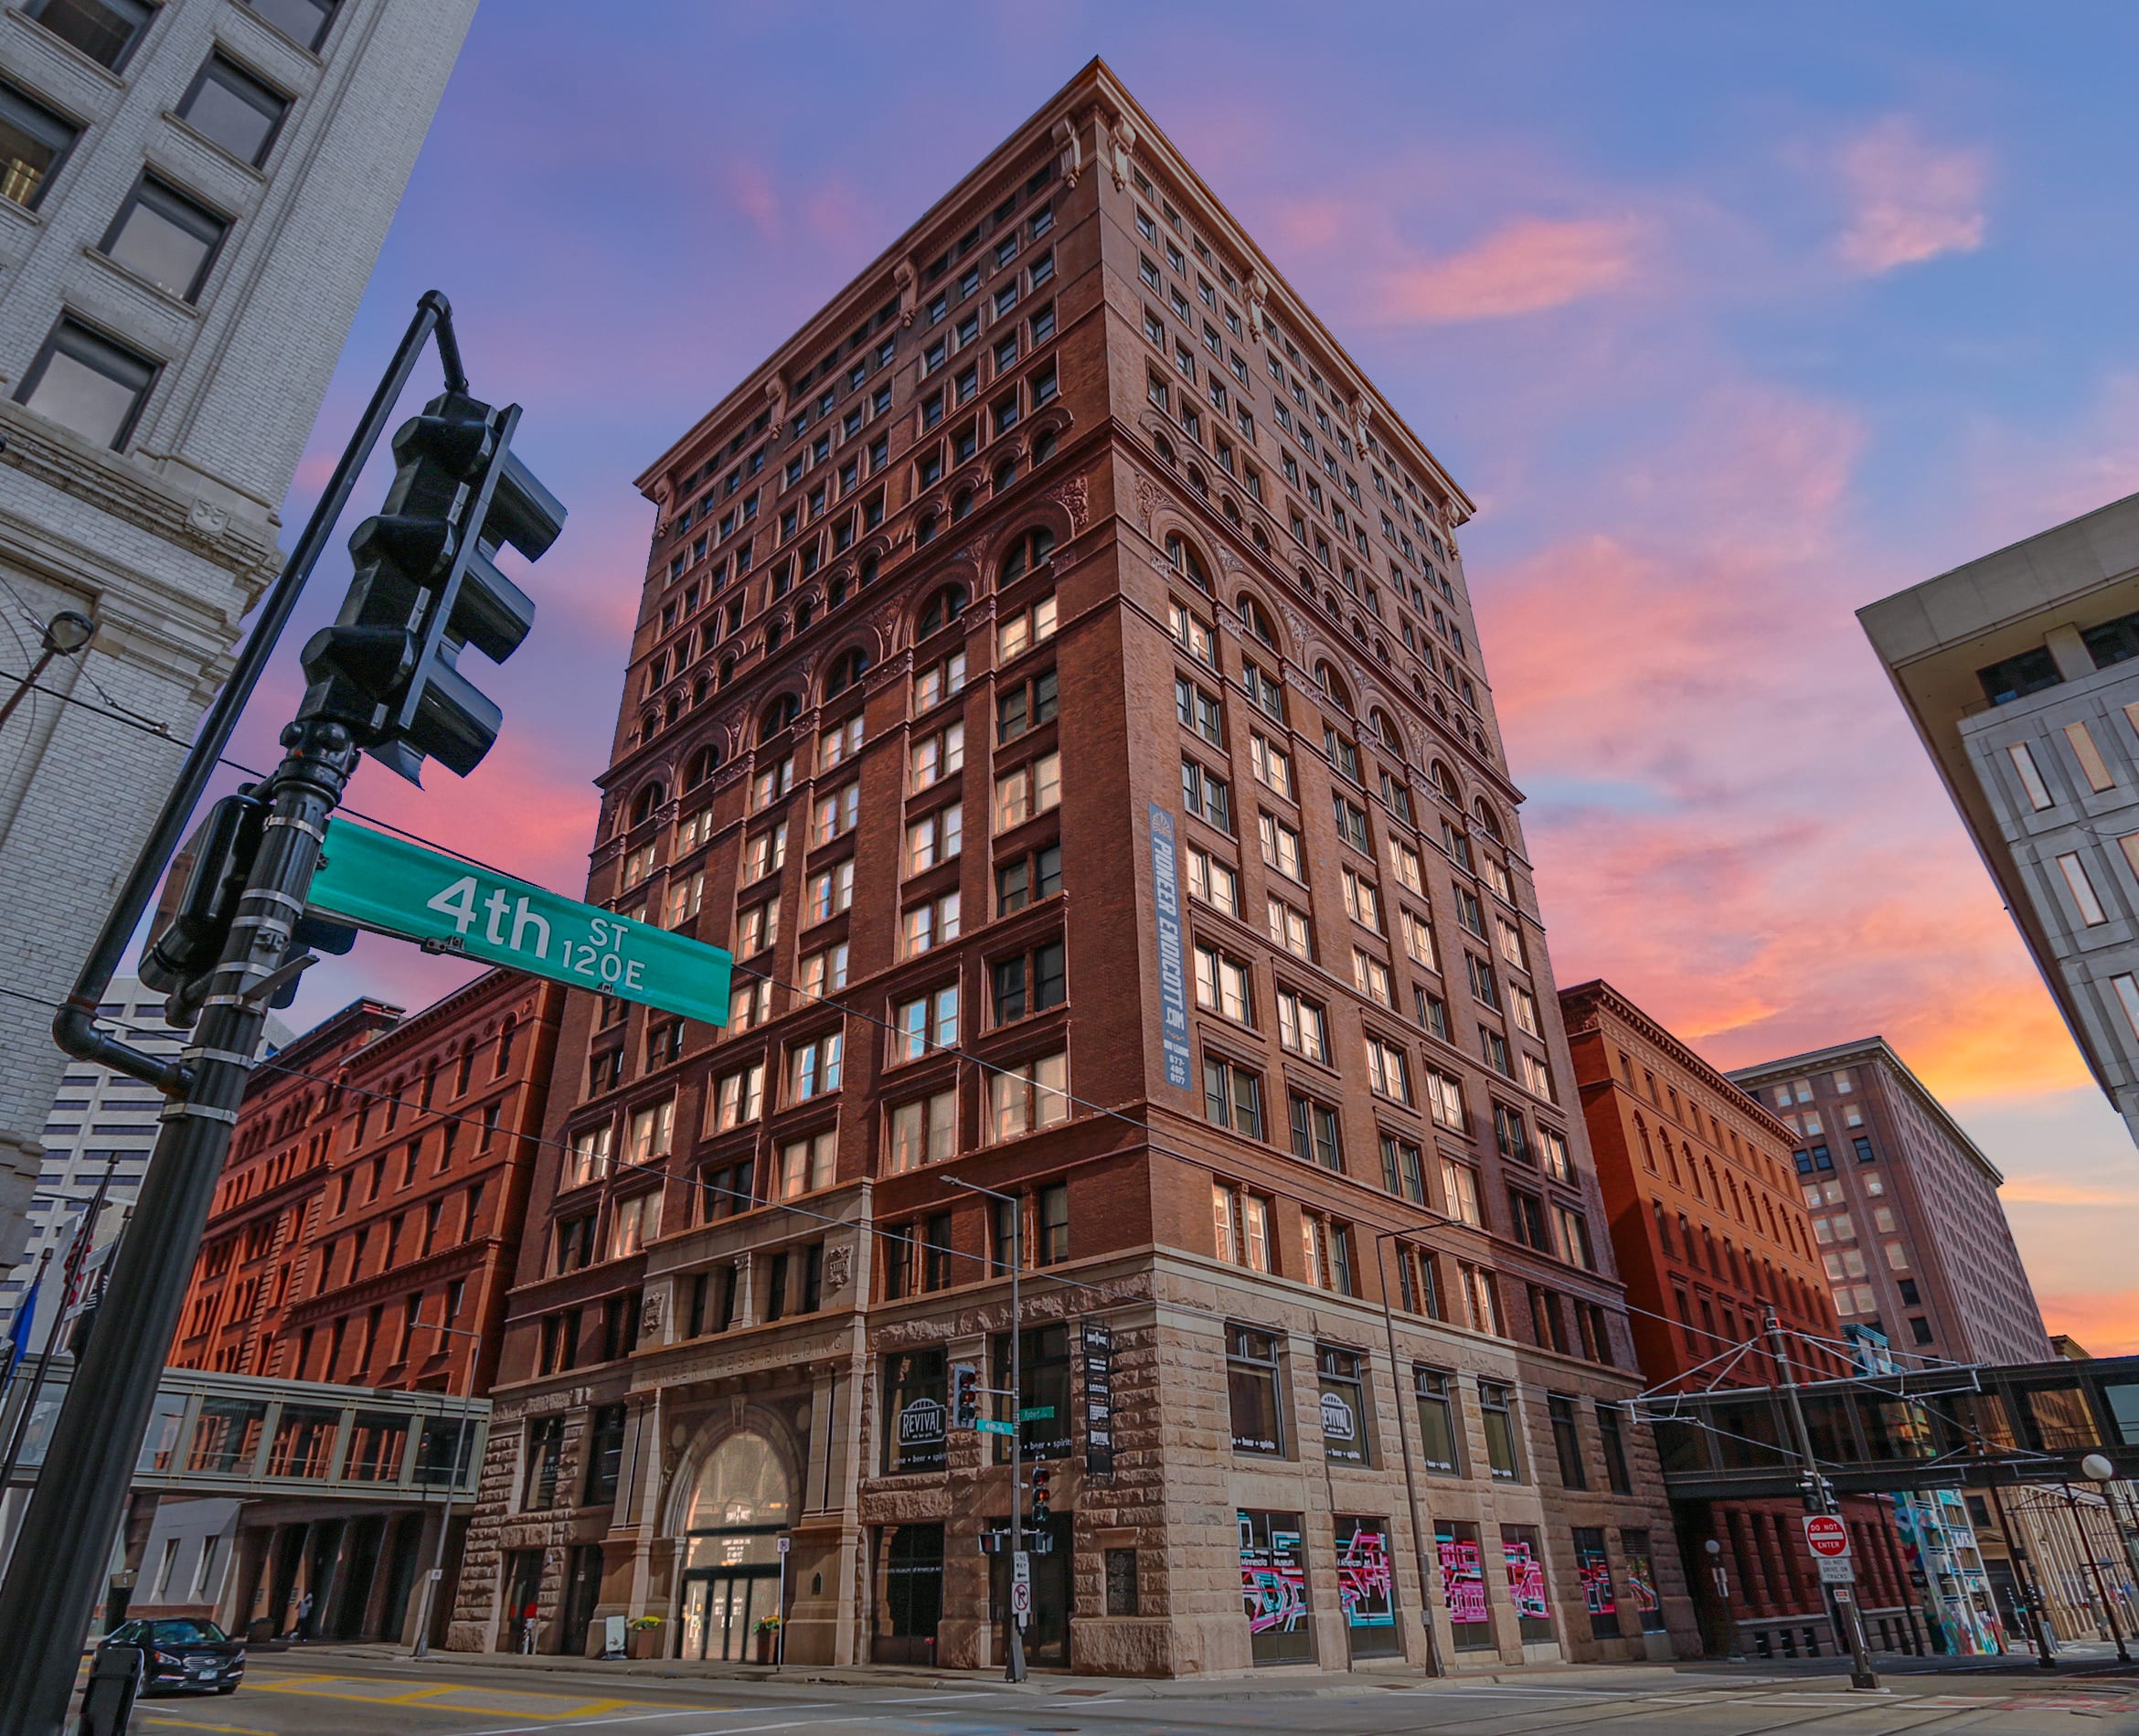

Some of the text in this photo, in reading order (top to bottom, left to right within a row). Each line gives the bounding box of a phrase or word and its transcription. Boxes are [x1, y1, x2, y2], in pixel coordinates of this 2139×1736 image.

[1155, 836, 1177, 917] PIONEER
[427, 876, 629, 959] 4th ST
[563, 940, 645, 991] 120E
[1159, 916, 1184, 1010] ENDICOTT
[707, 1350, 756, 1376] PRESS
[902, 1410, 942, 1439] REVIVAL
[912, 1454, 926, 1463] beer
[1030, 1442, 1045, 1450] beer
[1824, 1523, 1837, 1531] NOT
[1240, 1558, 1295, 1567] Minnesota Museum
